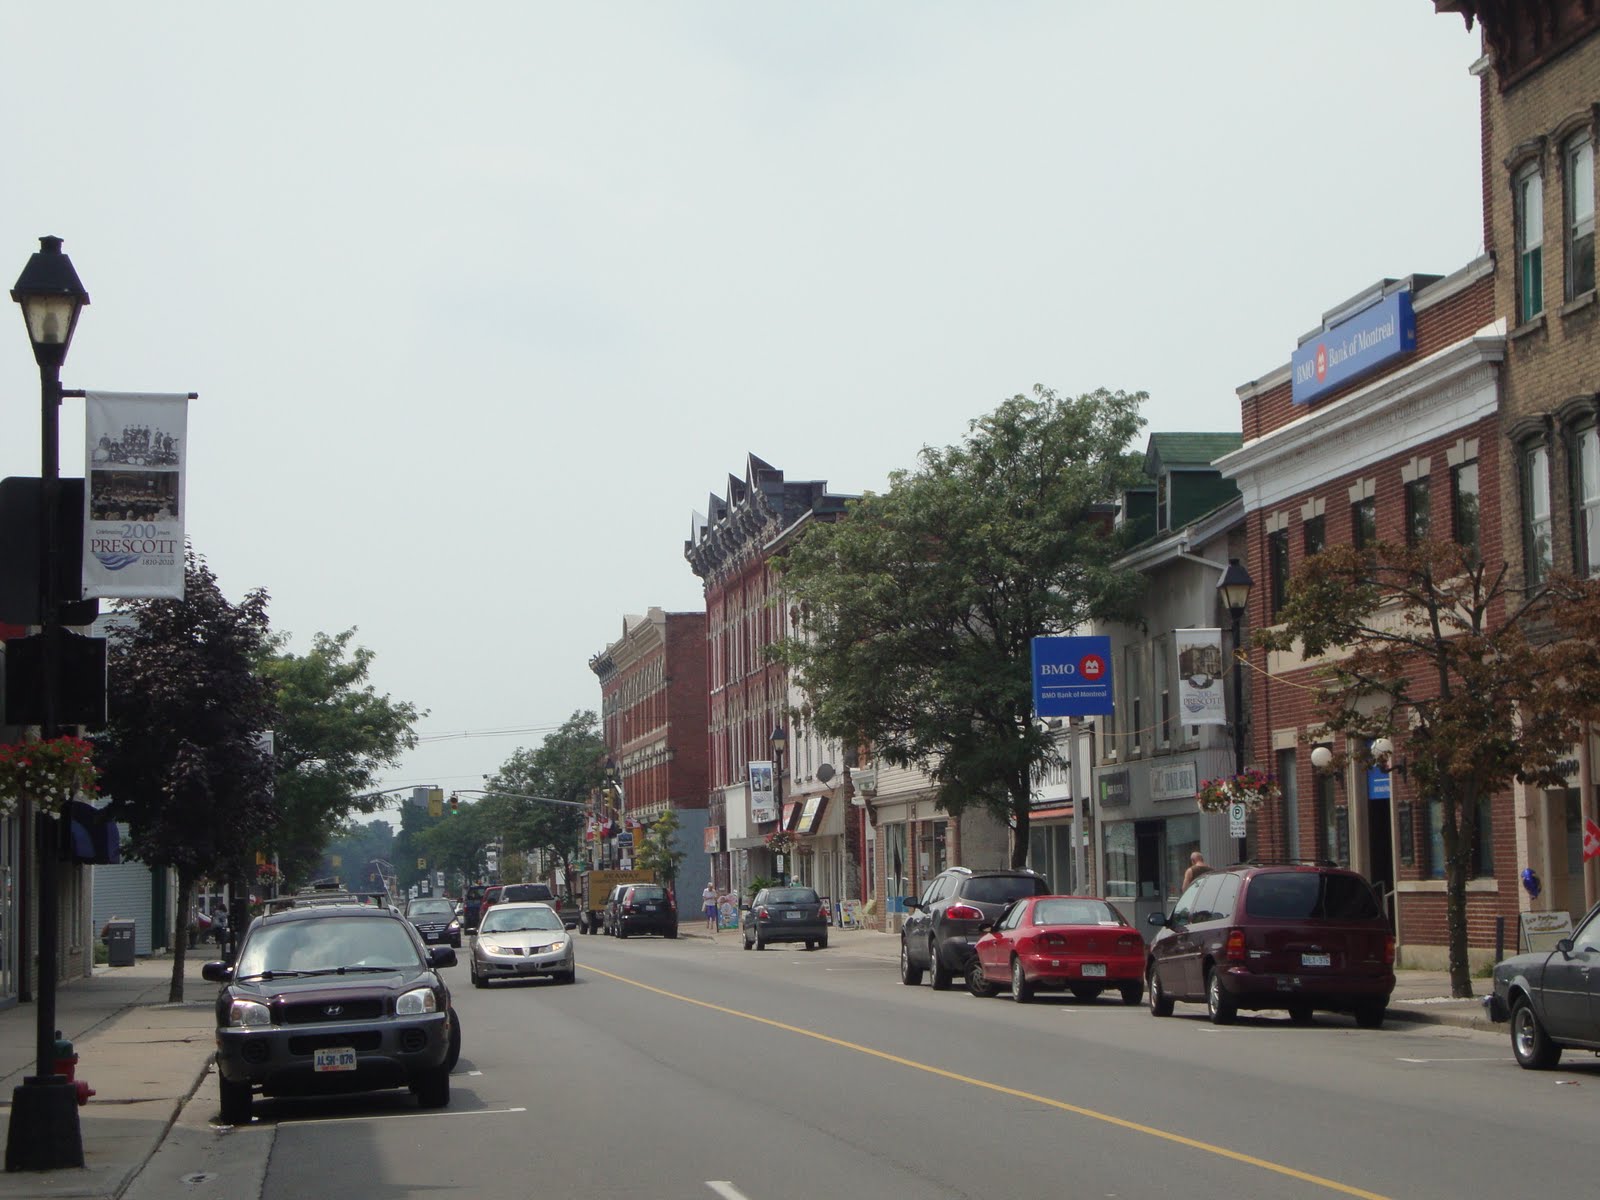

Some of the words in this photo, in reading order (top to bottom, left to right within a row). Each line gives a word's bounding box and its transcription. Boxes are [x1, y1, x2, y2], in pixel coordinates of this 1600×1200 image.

[1296, 359, 1314, 385] BMO
[1328, 340, 1348, 368] Bank
[1348, 336, 1358, 357] of
[1358, 313, 1395, 352] Montreal
[122, 523, 157, 539] 200
[90, 538, 178, 554] PRESCOTT
[142, 558, 175, 566] 1810-2010
[1040, 663, 1075, 676] BMO
[1057, 691, 1073, 699] Bank
[1073, 690, 1080, 698] of
[1080, 689, 1107, 698] Montreal
[1183, 697, 1222, 705] PRESCOTT
